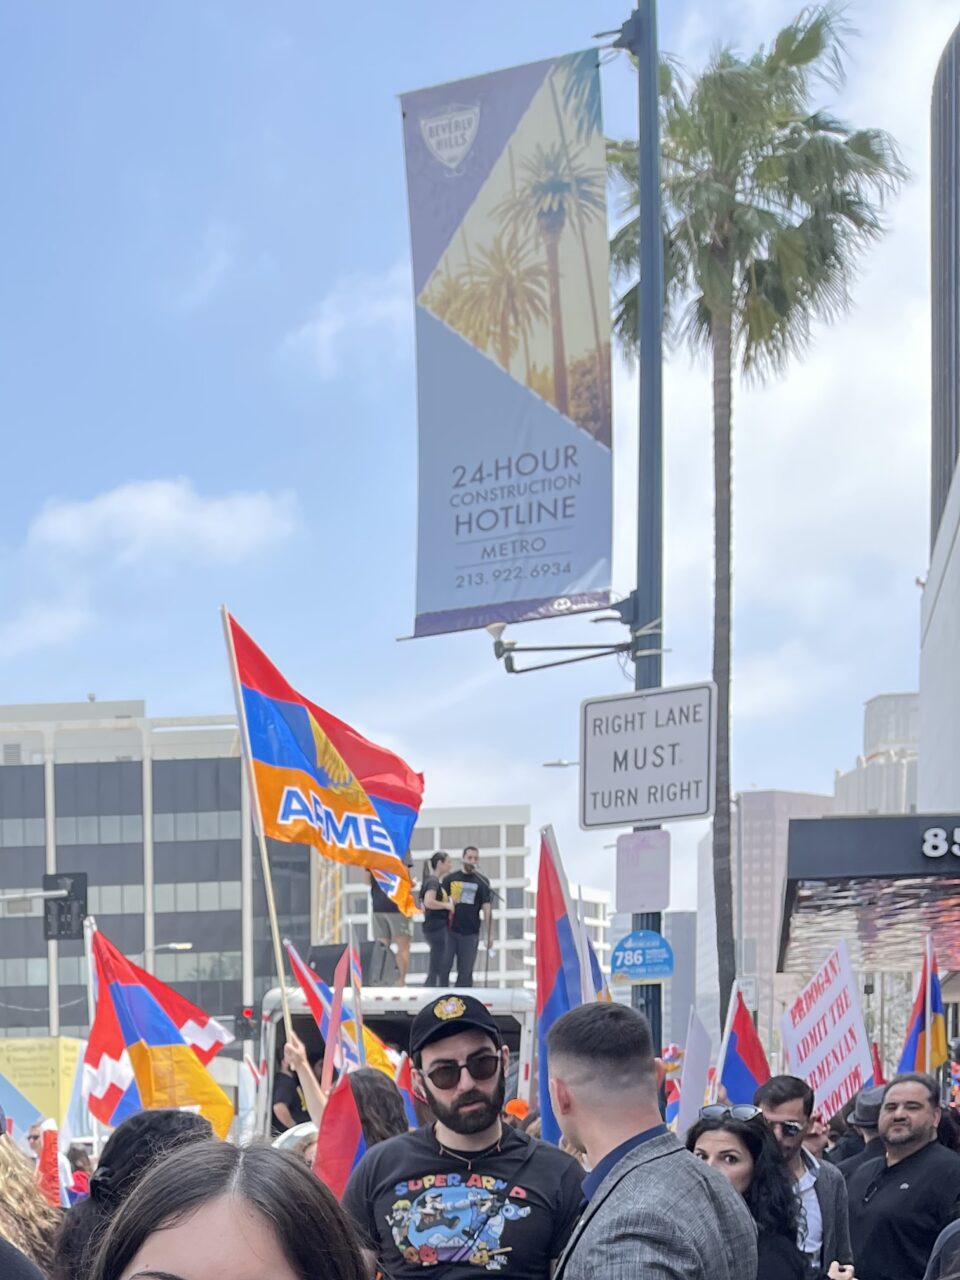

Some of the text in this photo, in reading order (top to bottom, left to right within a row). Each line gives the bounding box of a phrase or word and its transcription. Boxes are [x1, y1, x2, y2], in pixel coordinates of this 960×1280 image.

[452, 445, 578, 488] 24-HOUR
[449, 474, 581, 508] CONSTRUCTION
[455, 496, 576, 536] HOTLINE
[481, 537, 546, 560] METRO
[593, 703, 702, 736] RIGHT LANE
[613, 743, 680, 773] MUST
[591, 780, 702, 810] TURN RIGHT
[615, 949, 643, 967] 786
[796, 985, 851, 1064] ADMIT THE
[814, 1063, 863, 1126] ENOCIDE
[395, 1173, 461, 1196] SUPER
